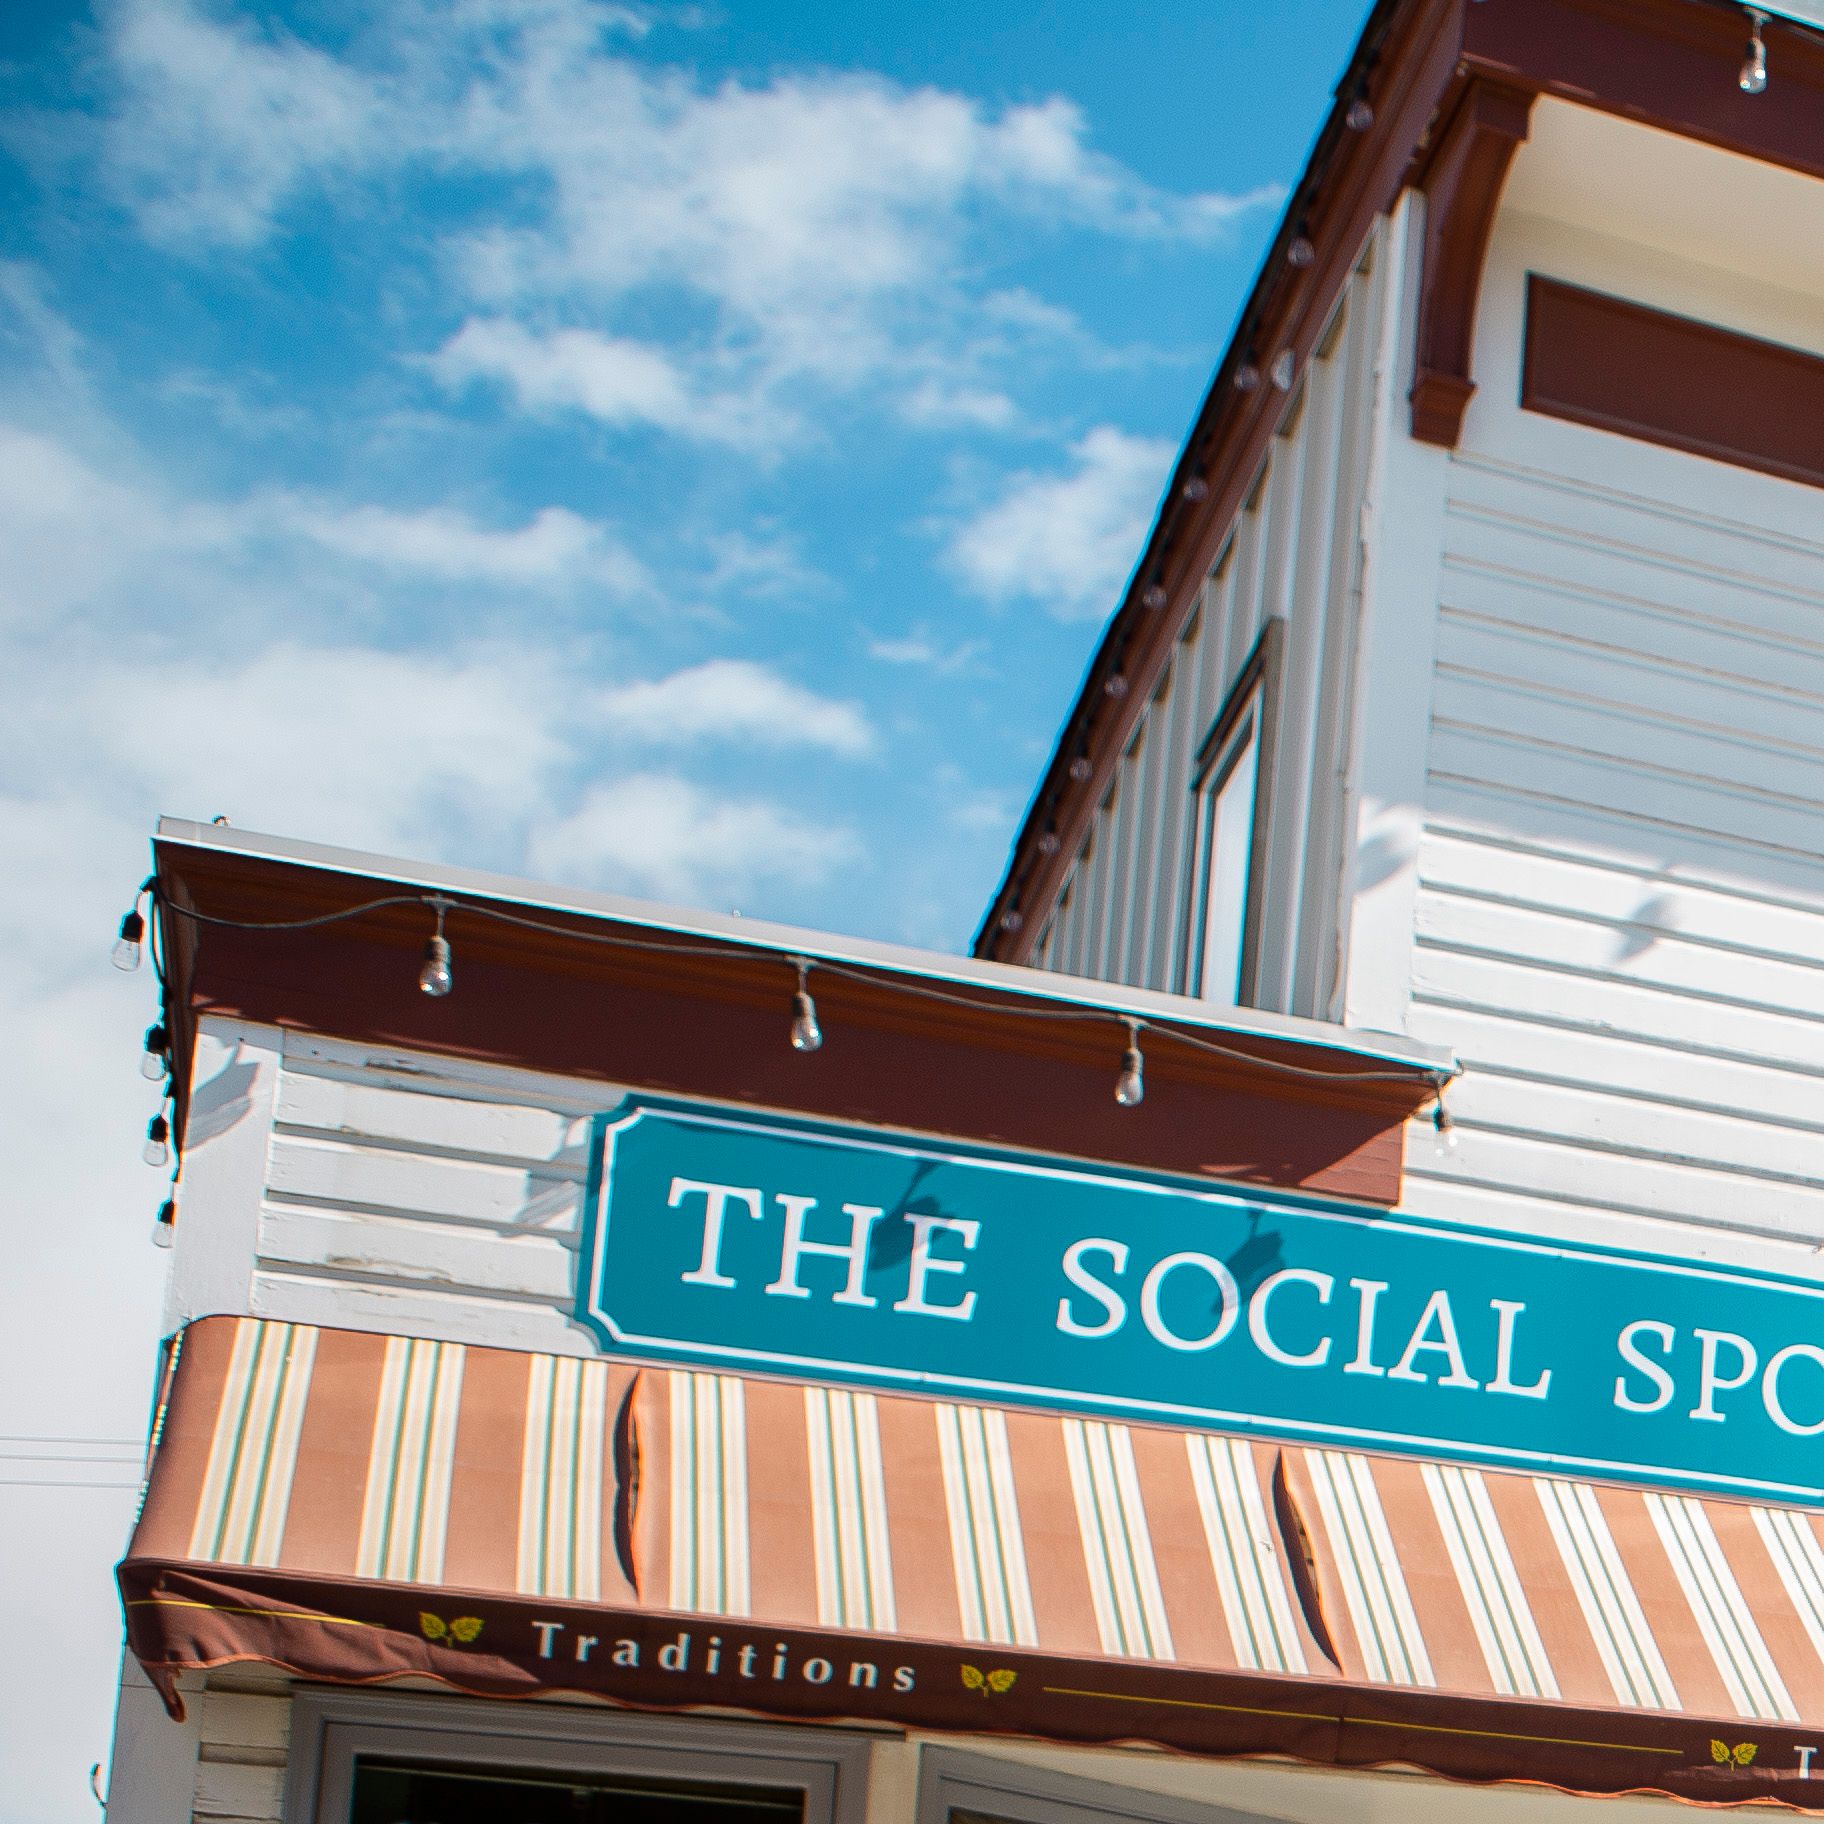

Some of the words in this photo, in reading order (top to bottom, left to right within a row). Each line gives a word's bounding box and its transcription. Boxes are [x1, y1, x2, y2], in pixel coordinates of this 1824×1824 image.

[666, 1176, 983, 1323] THE
[1054, 1236, 1554, 1401] SOCIAL
[530, 1619, 917, 1693] Traditions
